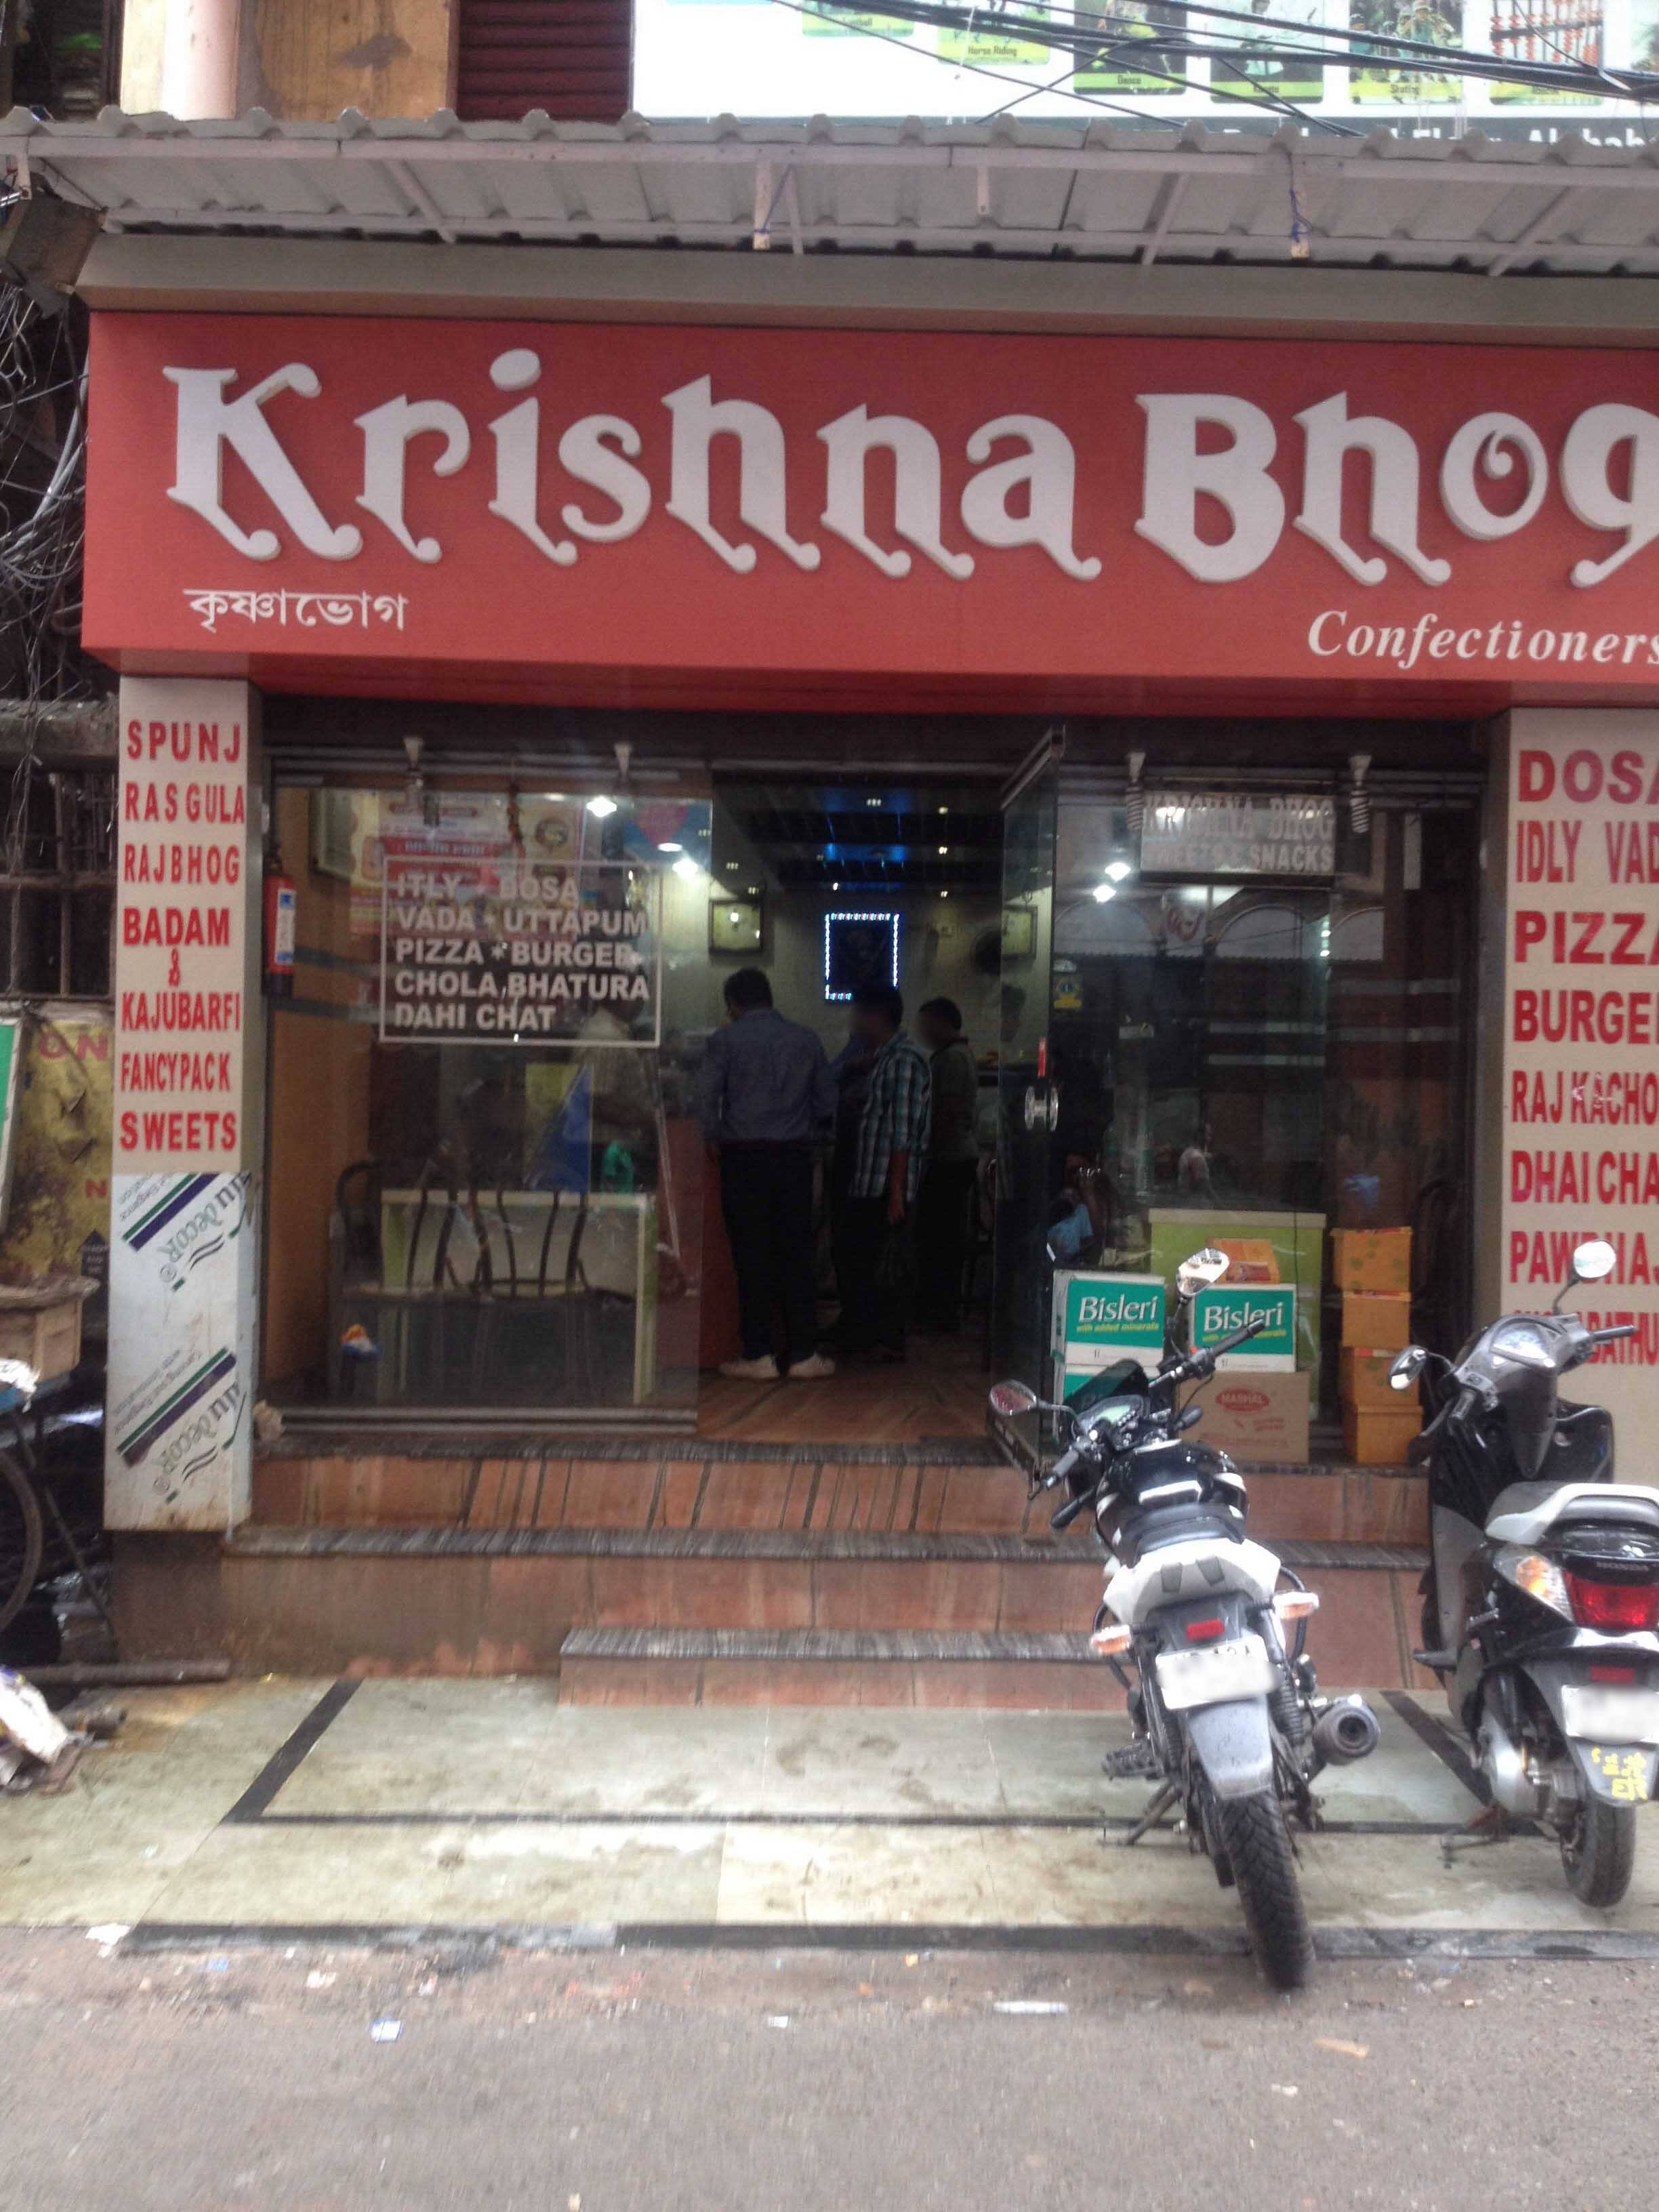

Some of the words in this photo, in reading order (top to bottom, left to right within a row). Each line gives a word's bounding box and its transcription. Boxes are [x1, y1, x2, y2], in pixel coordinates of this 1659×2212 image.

[163, 347, 1102, 581] Krishna
[1307, 610, 1659, 670] Confectioners
[127, 719, 240, 763] SPUNJ
[123, 844, 239, 885] RAJBHOG
[1516, 820, 1582, 883] IDLY
[123, 907, 230, 947] BADAM
[396, 907, 474, 933] VADA
[504, 907, 648, 935] UTTAPUM
[168, 947, 180, 987] &
[395, 939, 485, 965] PIZZA
[395, 970, 499, 997] CHOLA
[508, 972, 651, 1000] BHATURA
[121, 991, 241, 1031] KAJUBARFI
[394, 1003, 466, 1029] DAHI
[476, 1004, 557, 1031] CHAT
[1513, 989, 1659, 1045] BURGE
[121, 1052, 232, 1092] FANCYPACK
[120, 1110, 237, 1151] SWEETS
[1078, 1292, 1158, 1324] Bisleri
[1204, 1300, 1284, 1333] Bisleri
